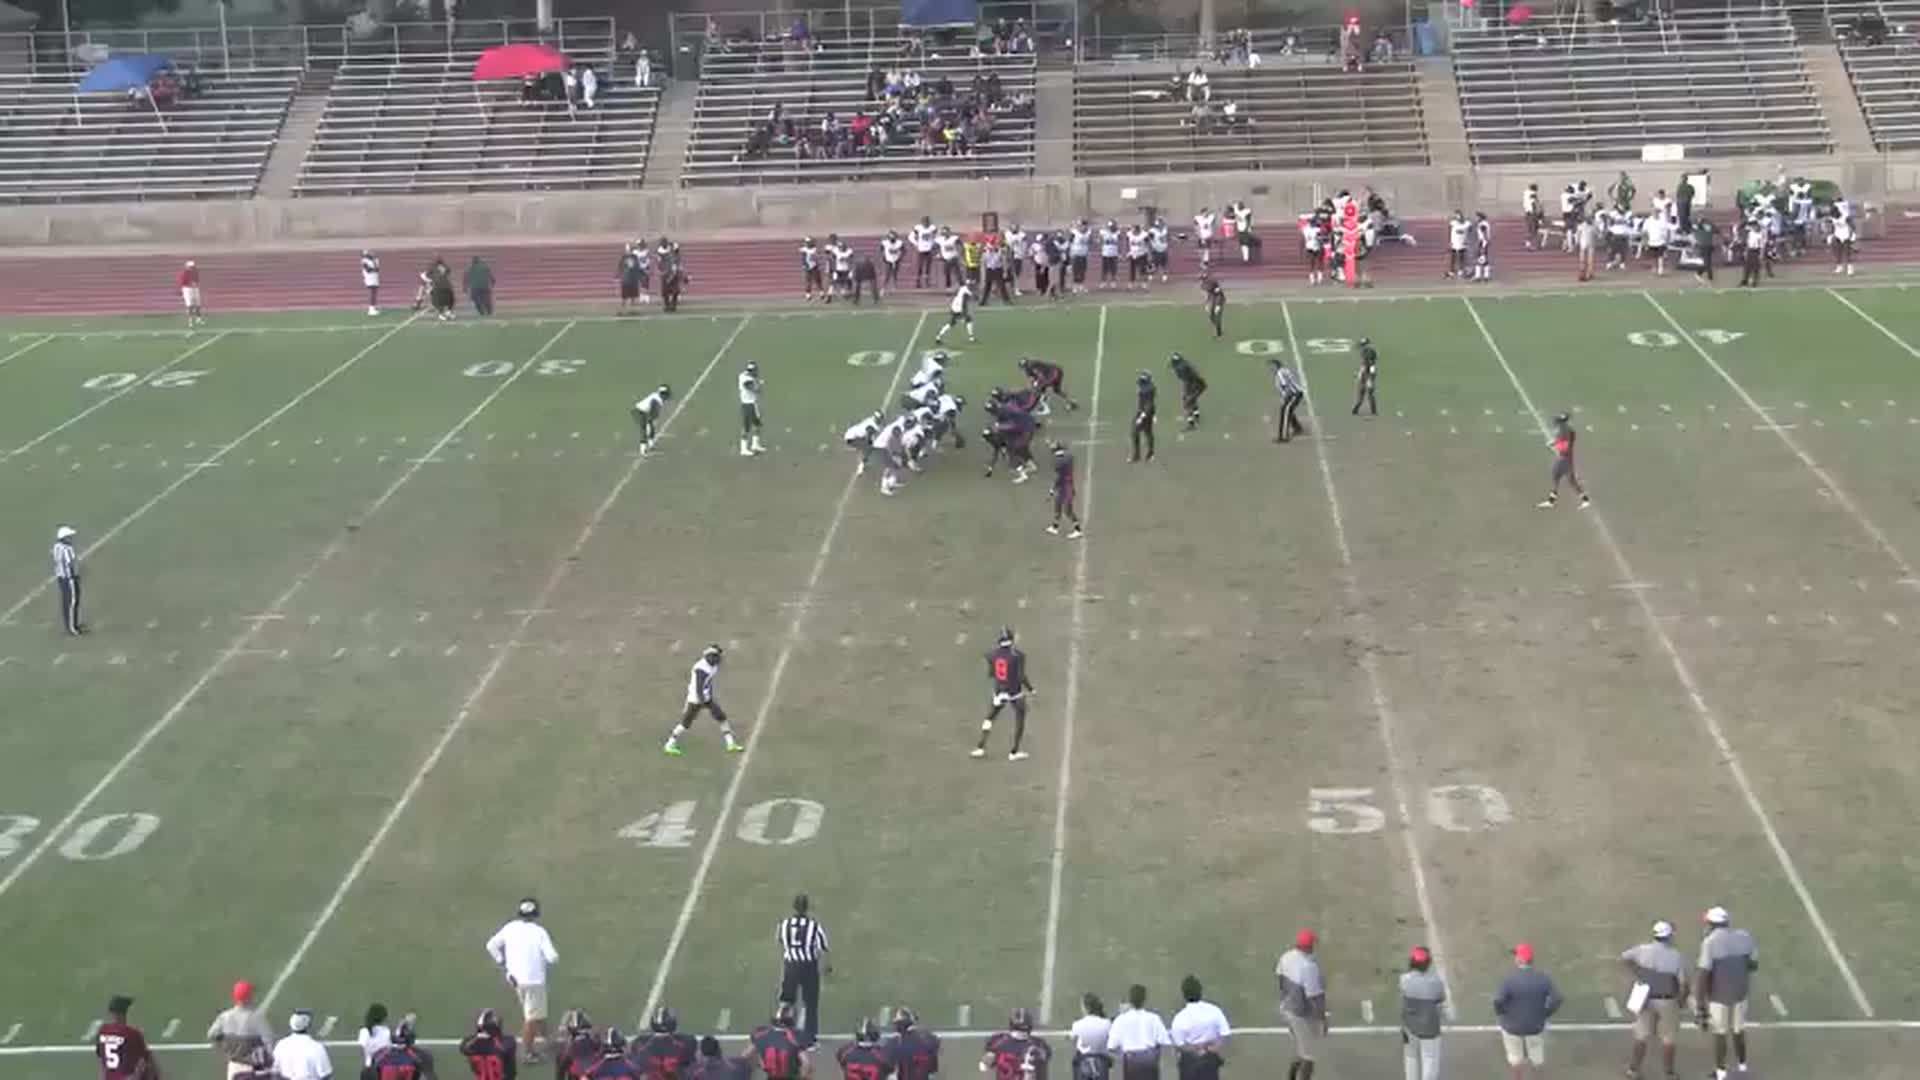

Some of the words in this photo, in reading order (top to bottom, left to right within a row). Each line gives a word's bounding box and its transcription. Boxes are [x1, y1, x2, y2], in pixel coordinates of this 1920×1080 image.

[1236, 338, 1351, 354] 50
[616, 798, 824, 847] 40
[1307, 785, 1512, 833] 50
[104, 1043, 119, 1069] 5
